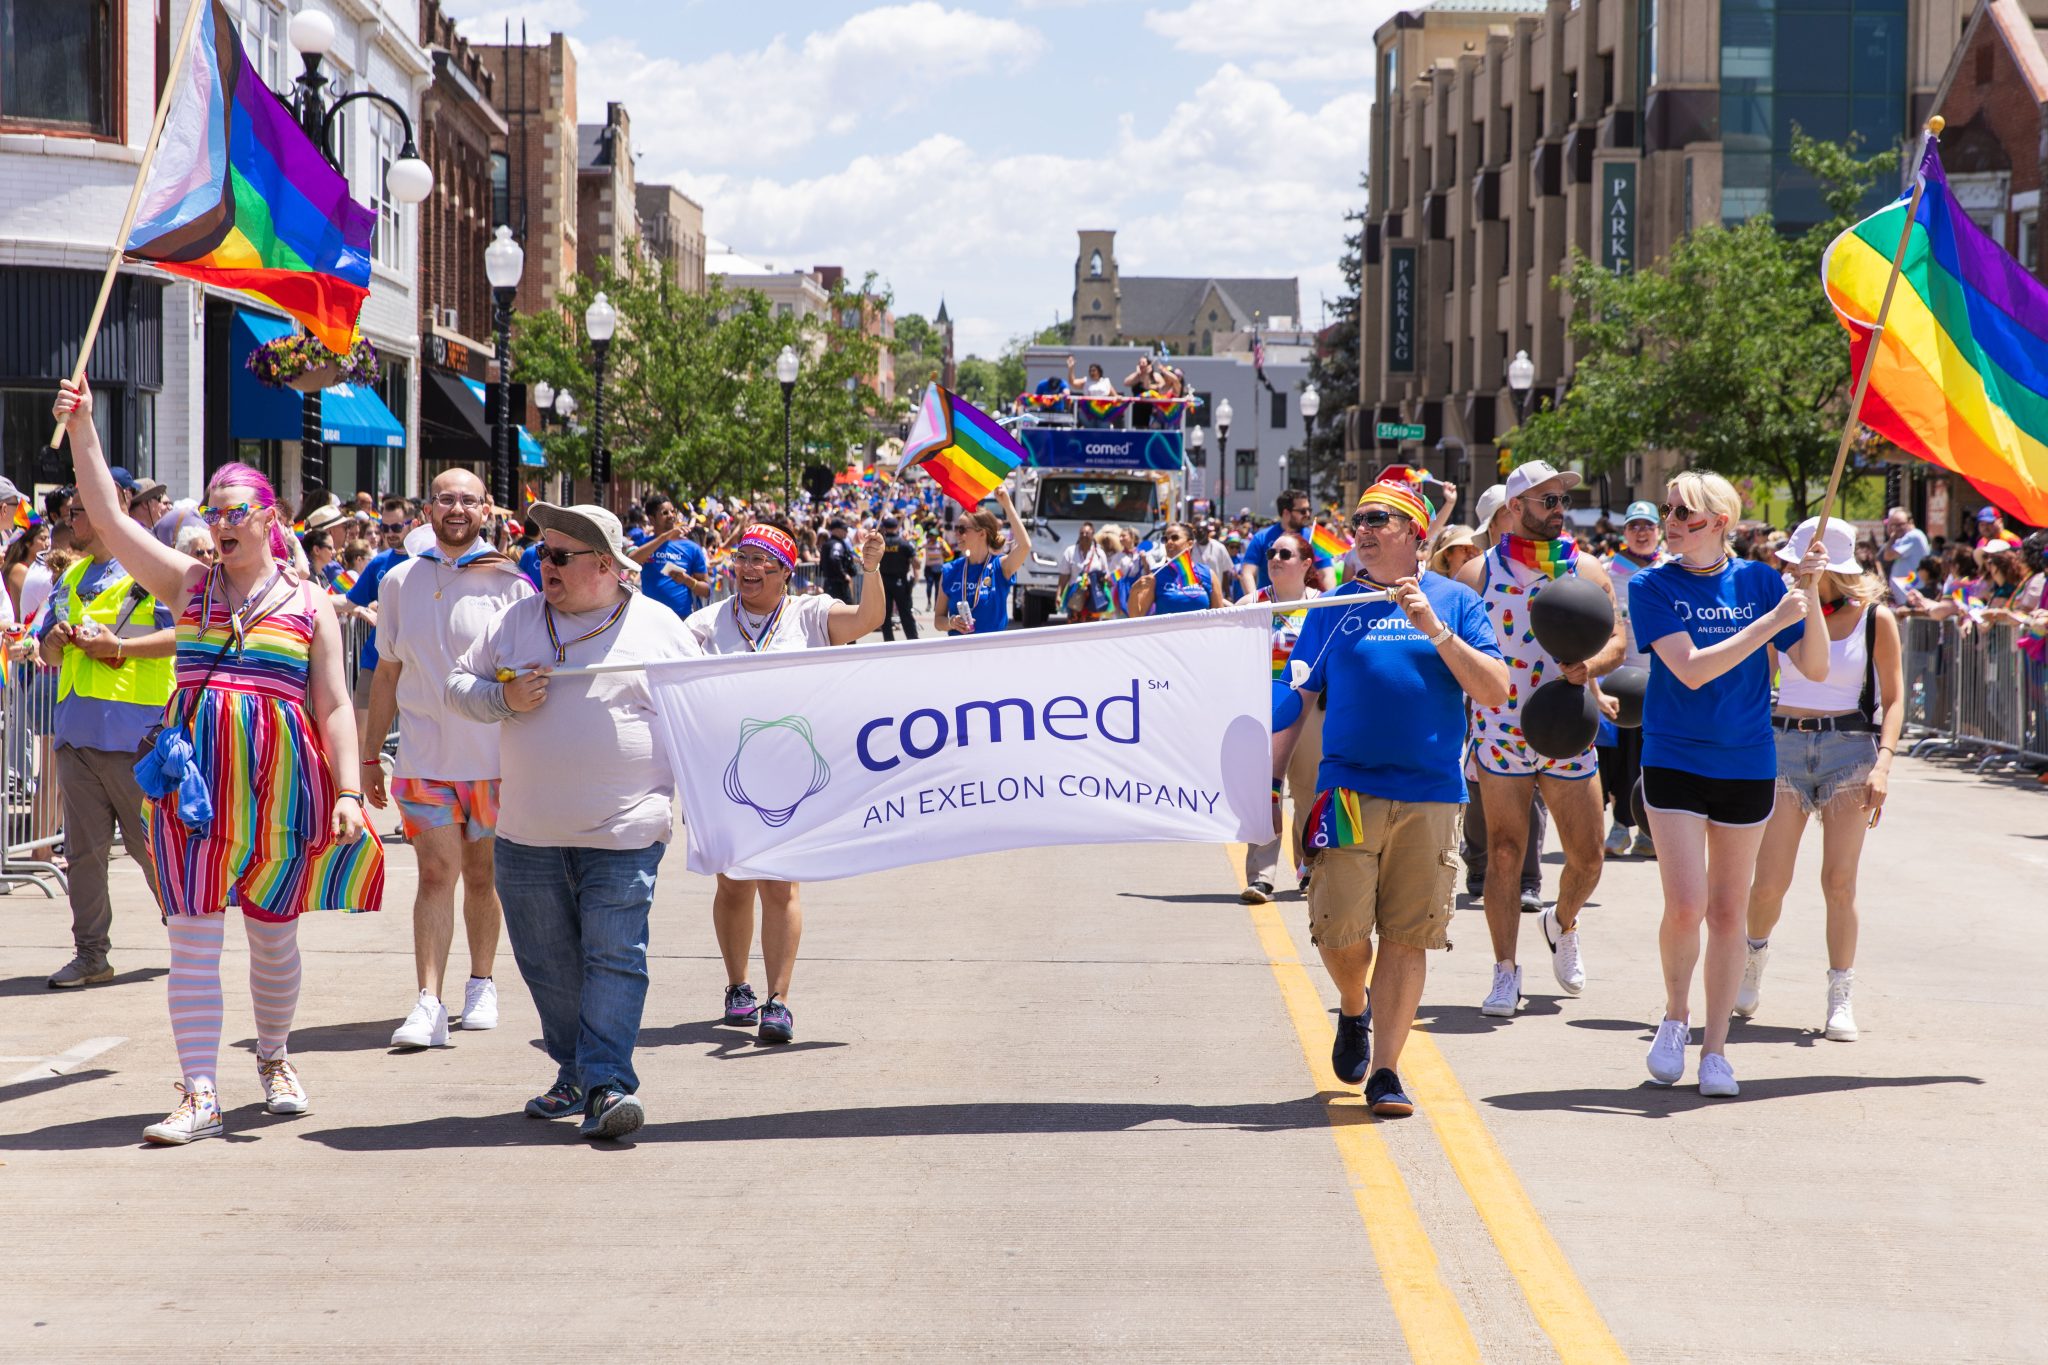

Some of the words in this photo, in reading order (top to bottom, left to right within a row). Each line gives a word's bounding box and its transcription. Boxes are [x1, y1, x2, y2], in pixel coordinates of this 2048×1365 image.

[1610, 178, 1627, 276] PARKI
[1394, 259, 1409, 360] PARKING
[1085, 441, 1129, 455] comed
[745, 525, 794, 551] omed
[1368, 618, 1416, 630] come
[1697, 602, 1753, 620] comed
[856, 678, 1140, 772] comed
[863, 796, 905, 828] AN
[919, 775, 1045, 815] EXELON
[1059, 774, 1220, 814] COMPANY
